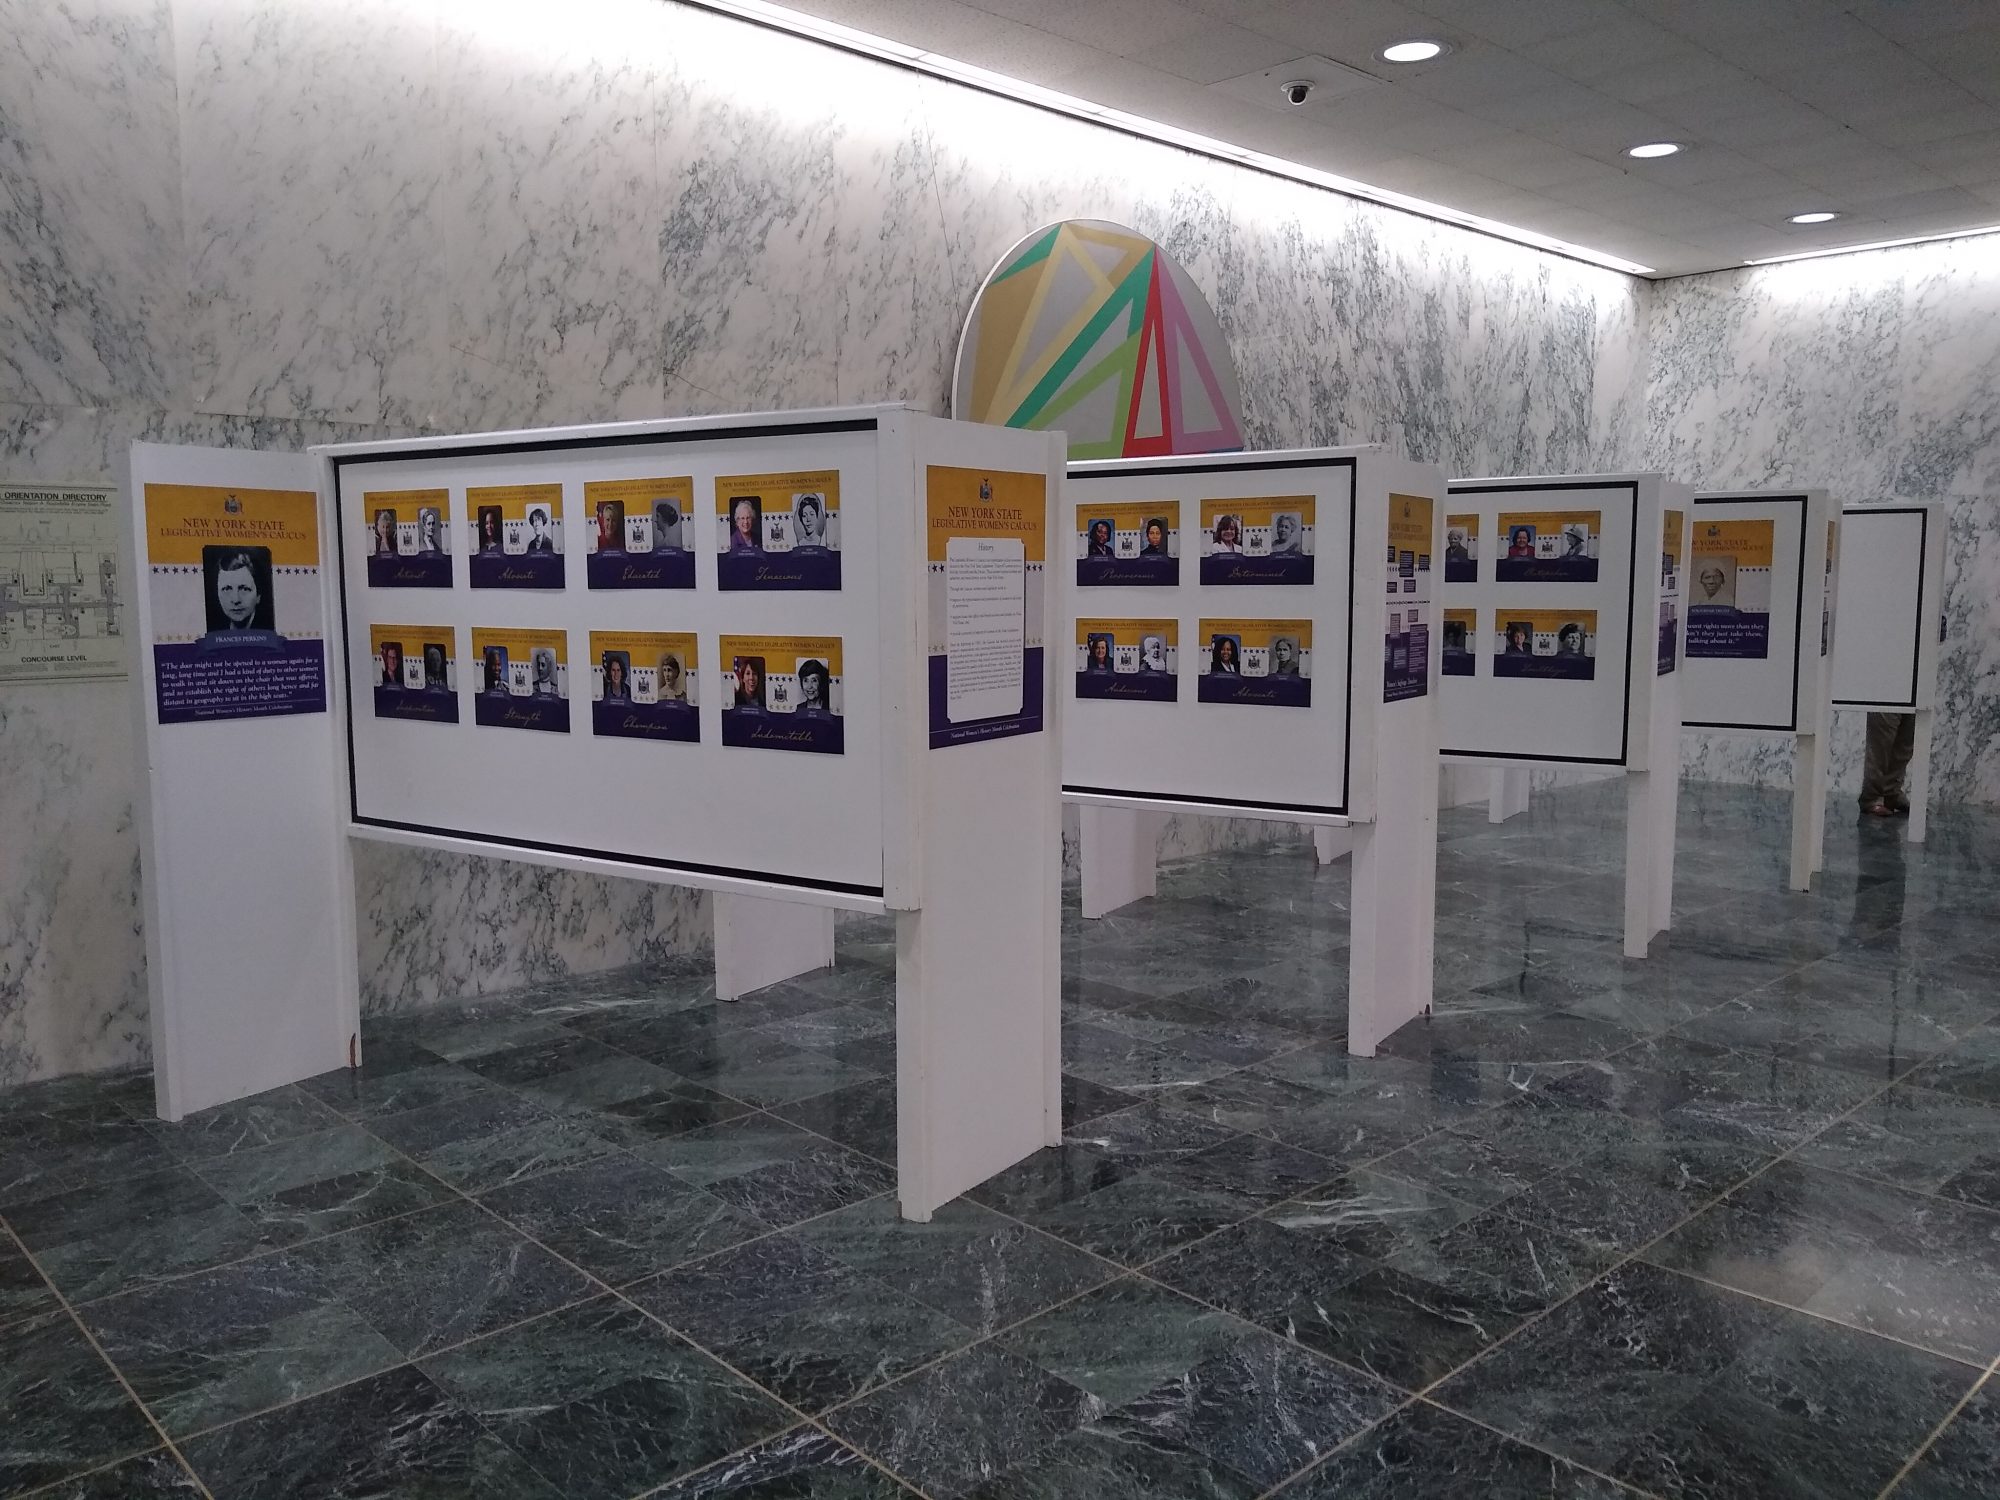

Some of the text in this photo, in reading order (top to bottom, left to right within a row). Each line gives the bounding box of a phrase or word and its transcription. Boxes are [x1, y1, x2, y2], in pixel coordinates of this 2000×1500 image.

[4, 492, 58, 500] ORIENTATION
[948, 506, 1022, 520] NEW YORK STATE
[183, 518, 285, 530] NEW YORK STATE
[932, 518, 1037, 530] LEGISLATIVE WOMEN'S CAUCUS
[161, 528, 306, 540] LEGISLATIVE WOMEN'S CAUCUS
[978, 542, 994, 552] History
[622, 565, 661, 580] Educated
[756, 566, 803, 580] Tenacious
[194, 660, 212, 670] might
[233, 659, 253, 668] opened
[179, 672, 192, 680] long
[225, 686, 239, 694] right
[311, 682, 319, 690] far
[194, 696, 223, 705] geography
[260, 692, 272, 700] high
[623, 715, 668, 732] Champion
[751, 725, 814, 741] Indomitable
